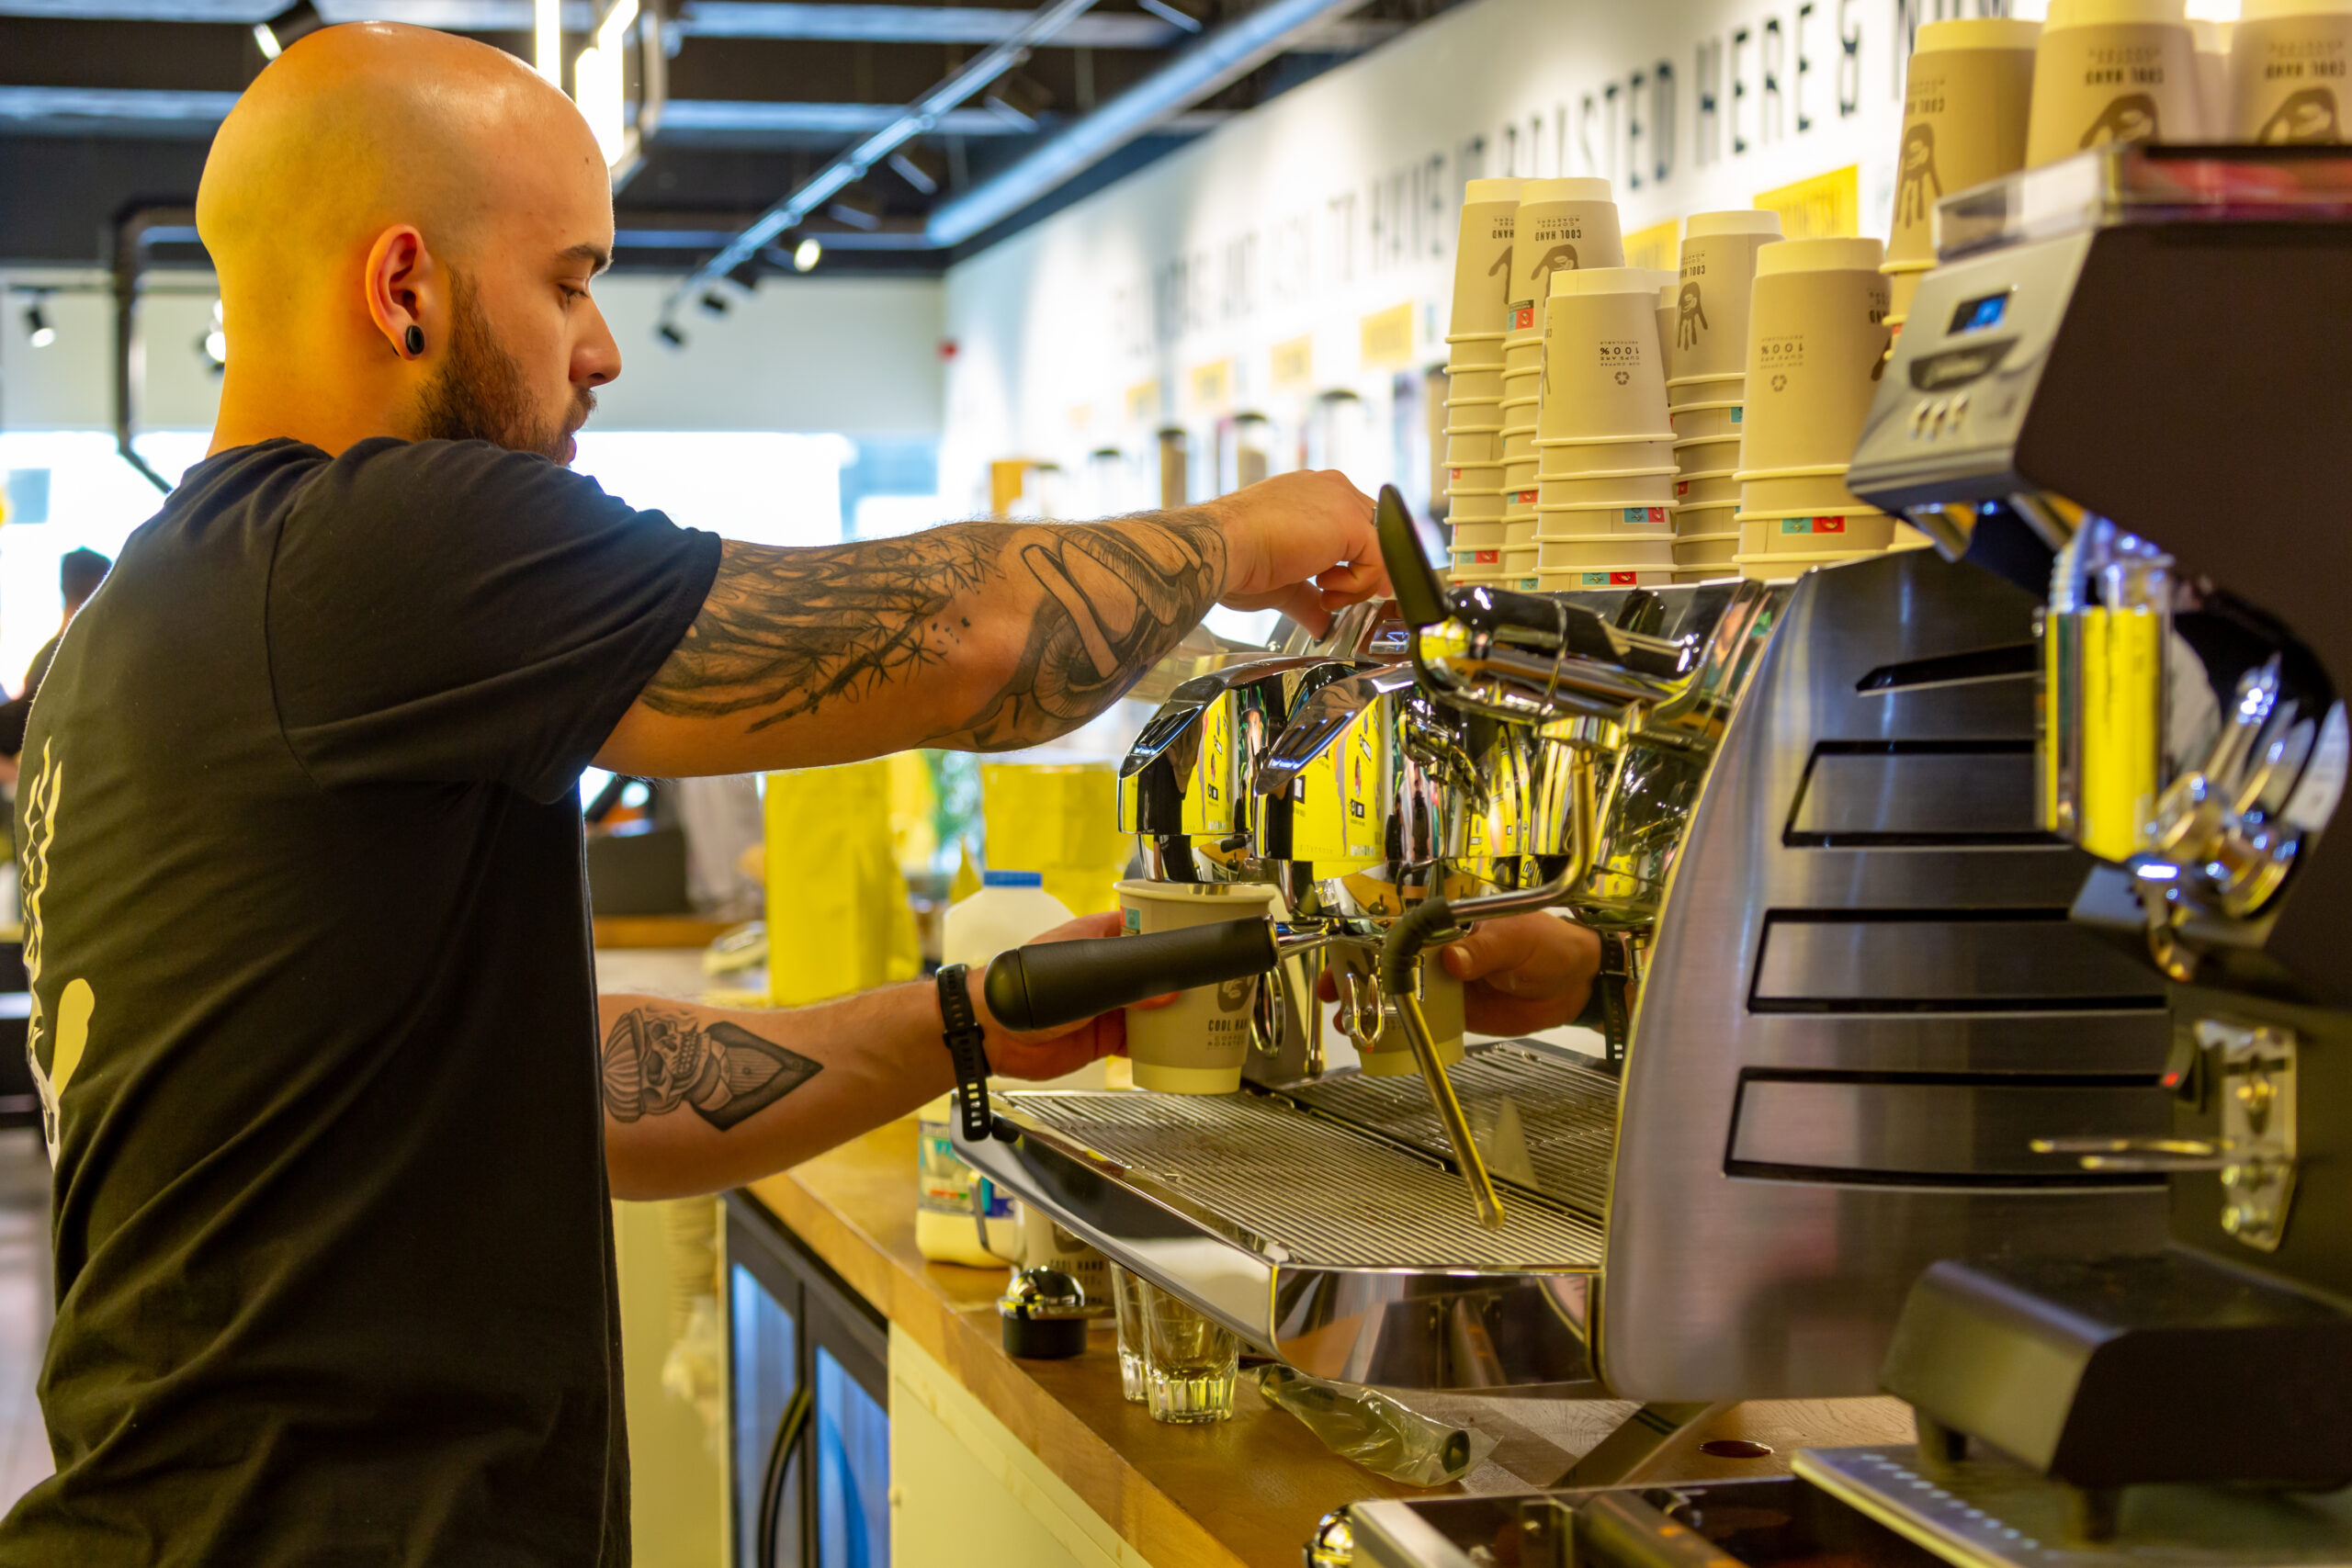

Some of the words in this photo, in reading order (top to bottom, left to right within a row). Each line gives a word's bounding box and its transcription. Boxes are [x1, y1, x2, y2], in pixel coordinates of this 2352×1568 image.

[1695, 3, 1813, 166] HERE
[1534, 231, 1556, 242] HAND
[1560, 229, 1581, 240] COOL
[1208, 1020, 1231, 1032] COOL
